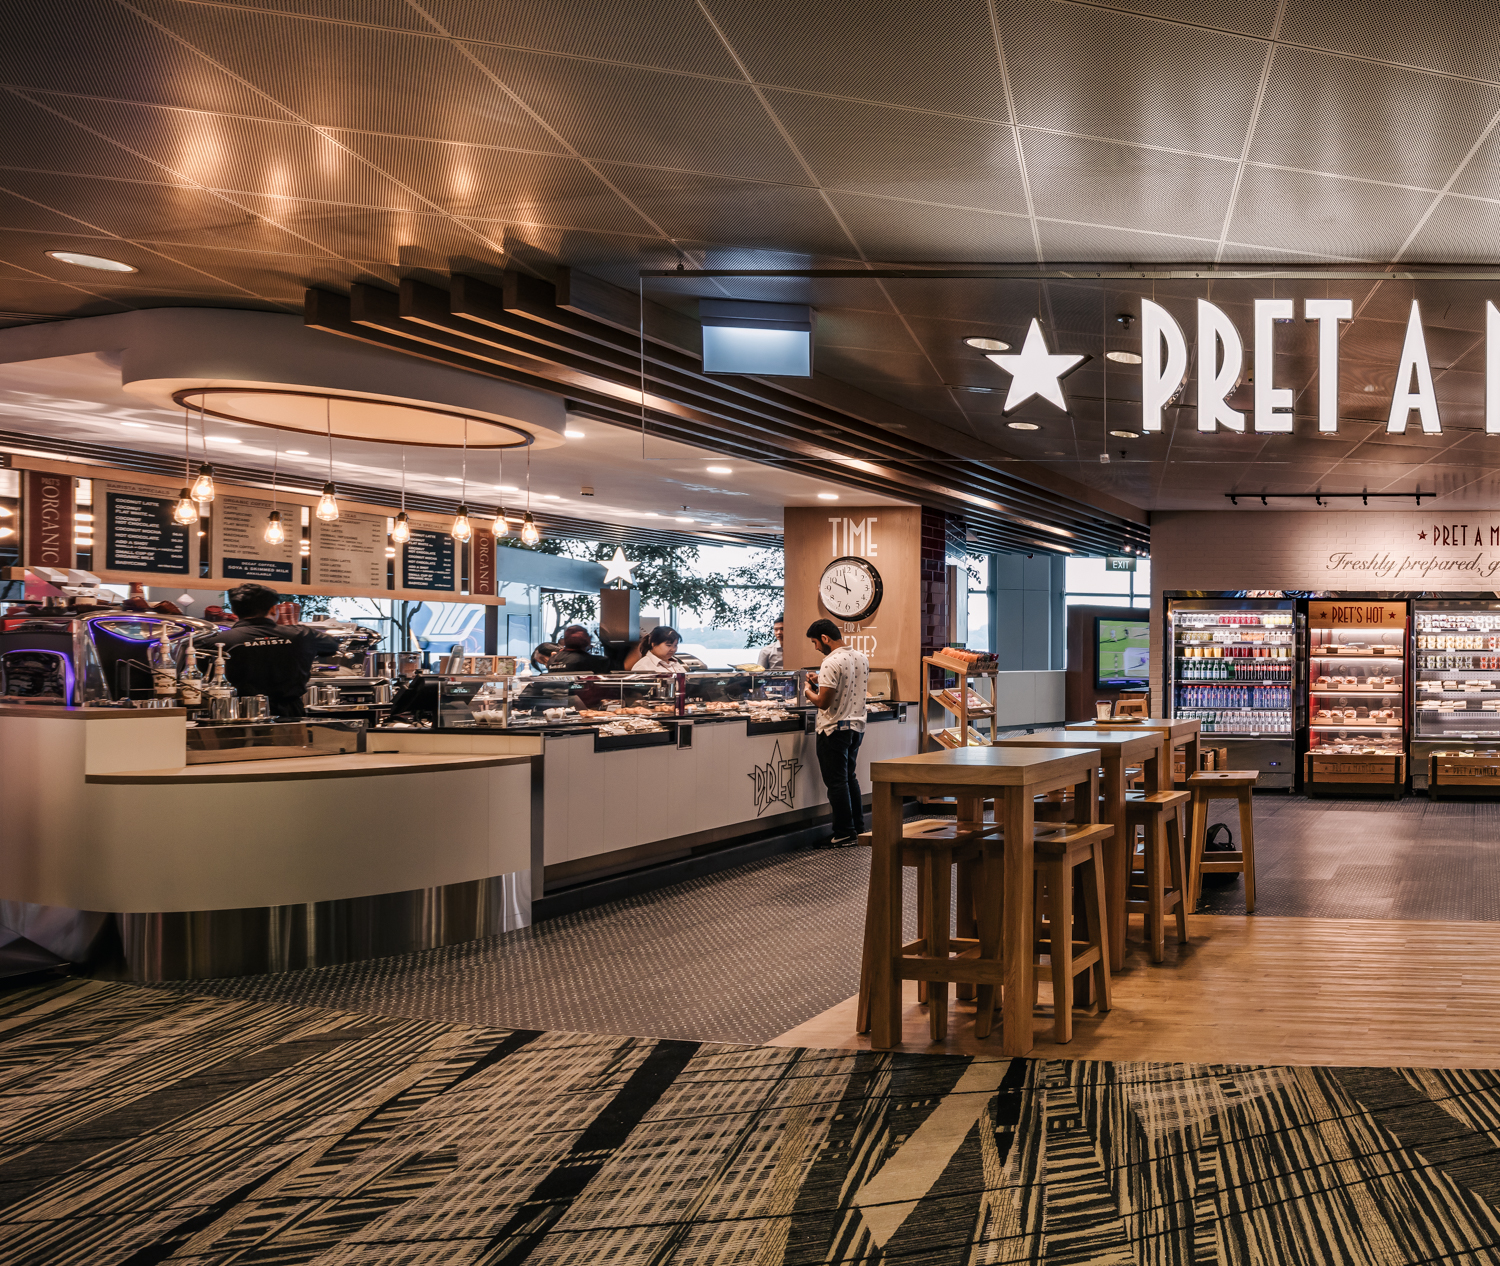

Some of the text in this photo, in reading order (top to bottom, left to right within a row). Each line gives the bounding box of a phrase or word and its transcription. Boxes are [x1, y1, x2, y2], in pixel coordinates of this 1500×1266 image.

[1141, 297, 1352, 433] PRET
[1386, 298, 1443, 434] A
[41, 486, 60, 563] ORGANIC
[828, 517, 877, 557] TIME
[1433, 525, 1466, 546] PRET
[1474, 525, 1482, 546] A
[480, 537, 490, 592] ORGANIC
[1112, 560, 1130, 569] EXIT
[1325, 551, 1398, 578] Freshly
[1394, 552, 1482, 578] prepared,
[844, 622, 861, 633] FOR A
[1332, 606, 1384, 623] PRET'S HOT
[244, 639, 292, 647] BARISTA
[754, 758, 798, 806] PRET
